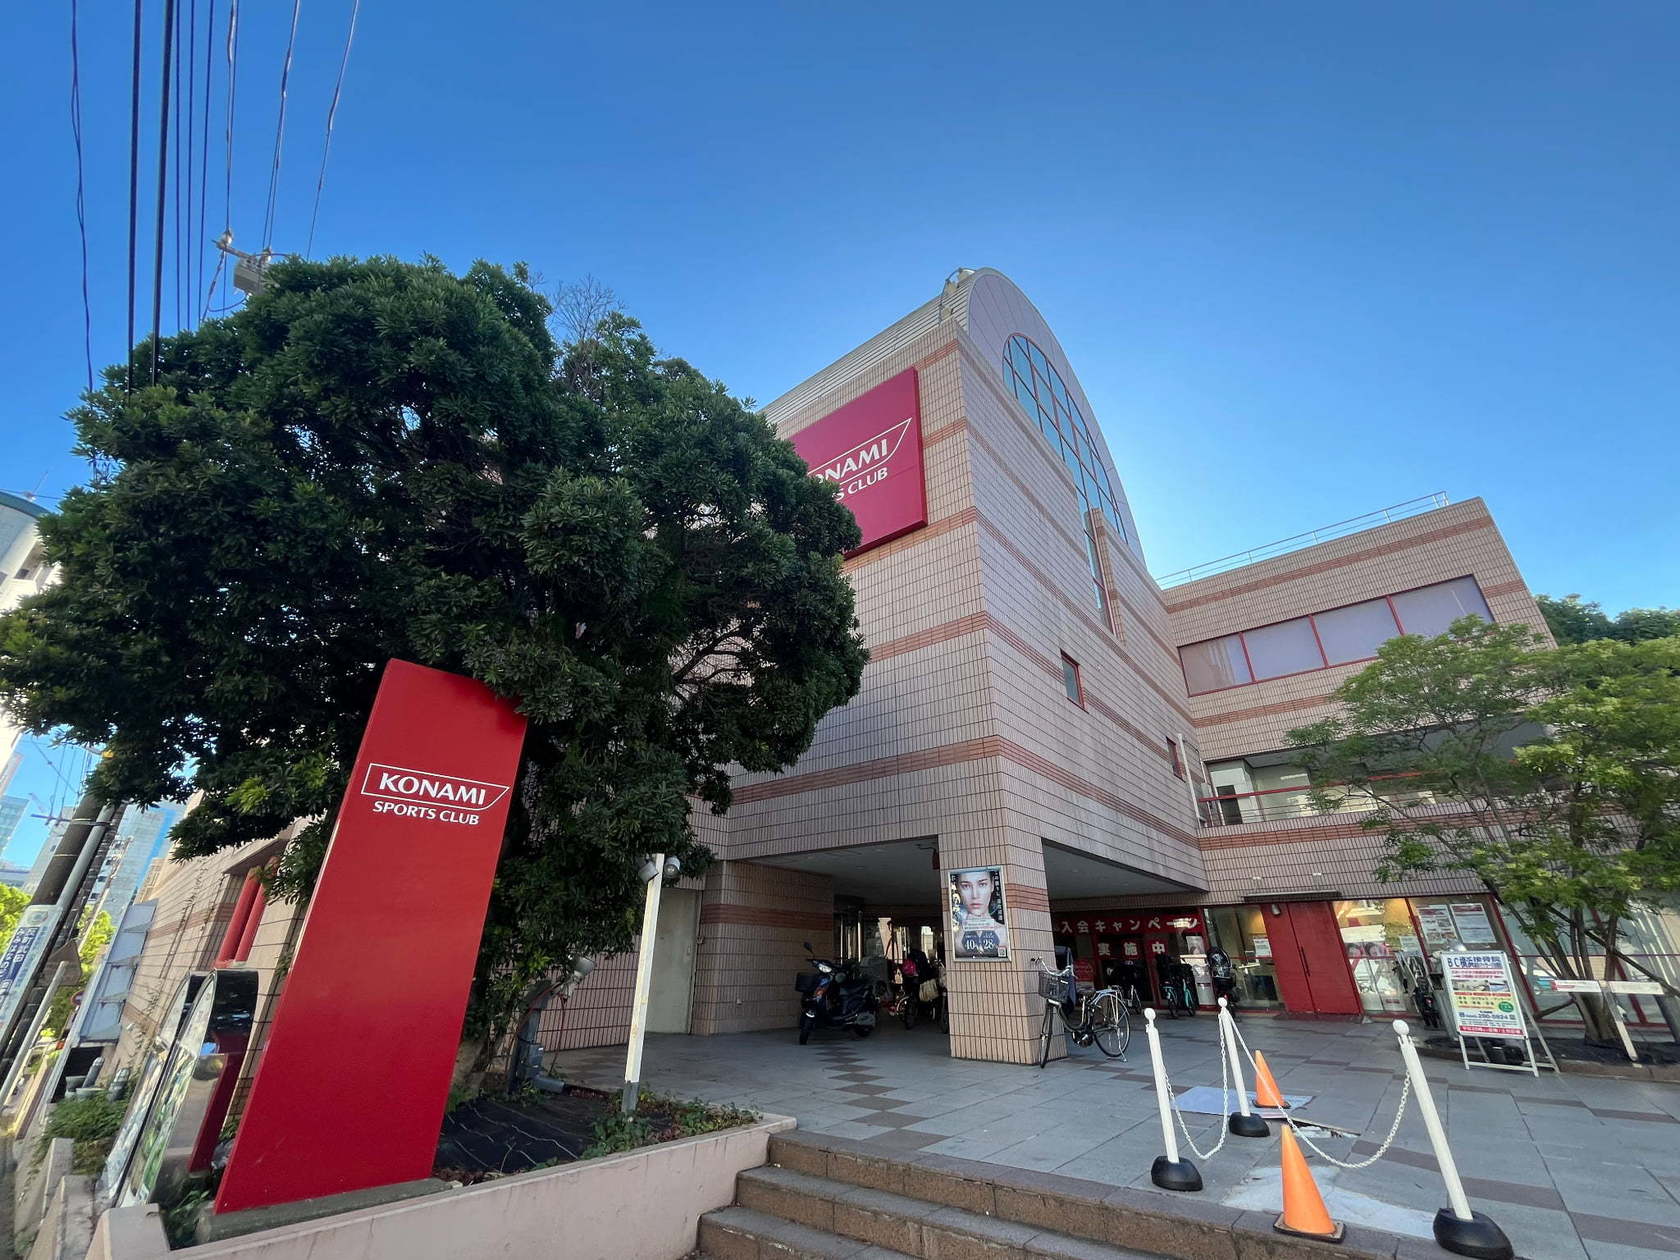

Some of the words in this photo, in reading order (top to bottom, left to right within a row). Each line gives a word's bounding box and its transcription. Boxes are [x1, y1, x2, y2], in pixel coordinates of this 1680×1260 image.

[848, 467, 888, 494] CLUB
[379, 772, 486, 805] KONAMI
[372, 800, 437, 820] SPORTS
[439, 810, 480, 825] CLUB
[1055, 917, 1198, 933] 入会キャンペーン
[1097, 941, 1166, 956] 実施中
